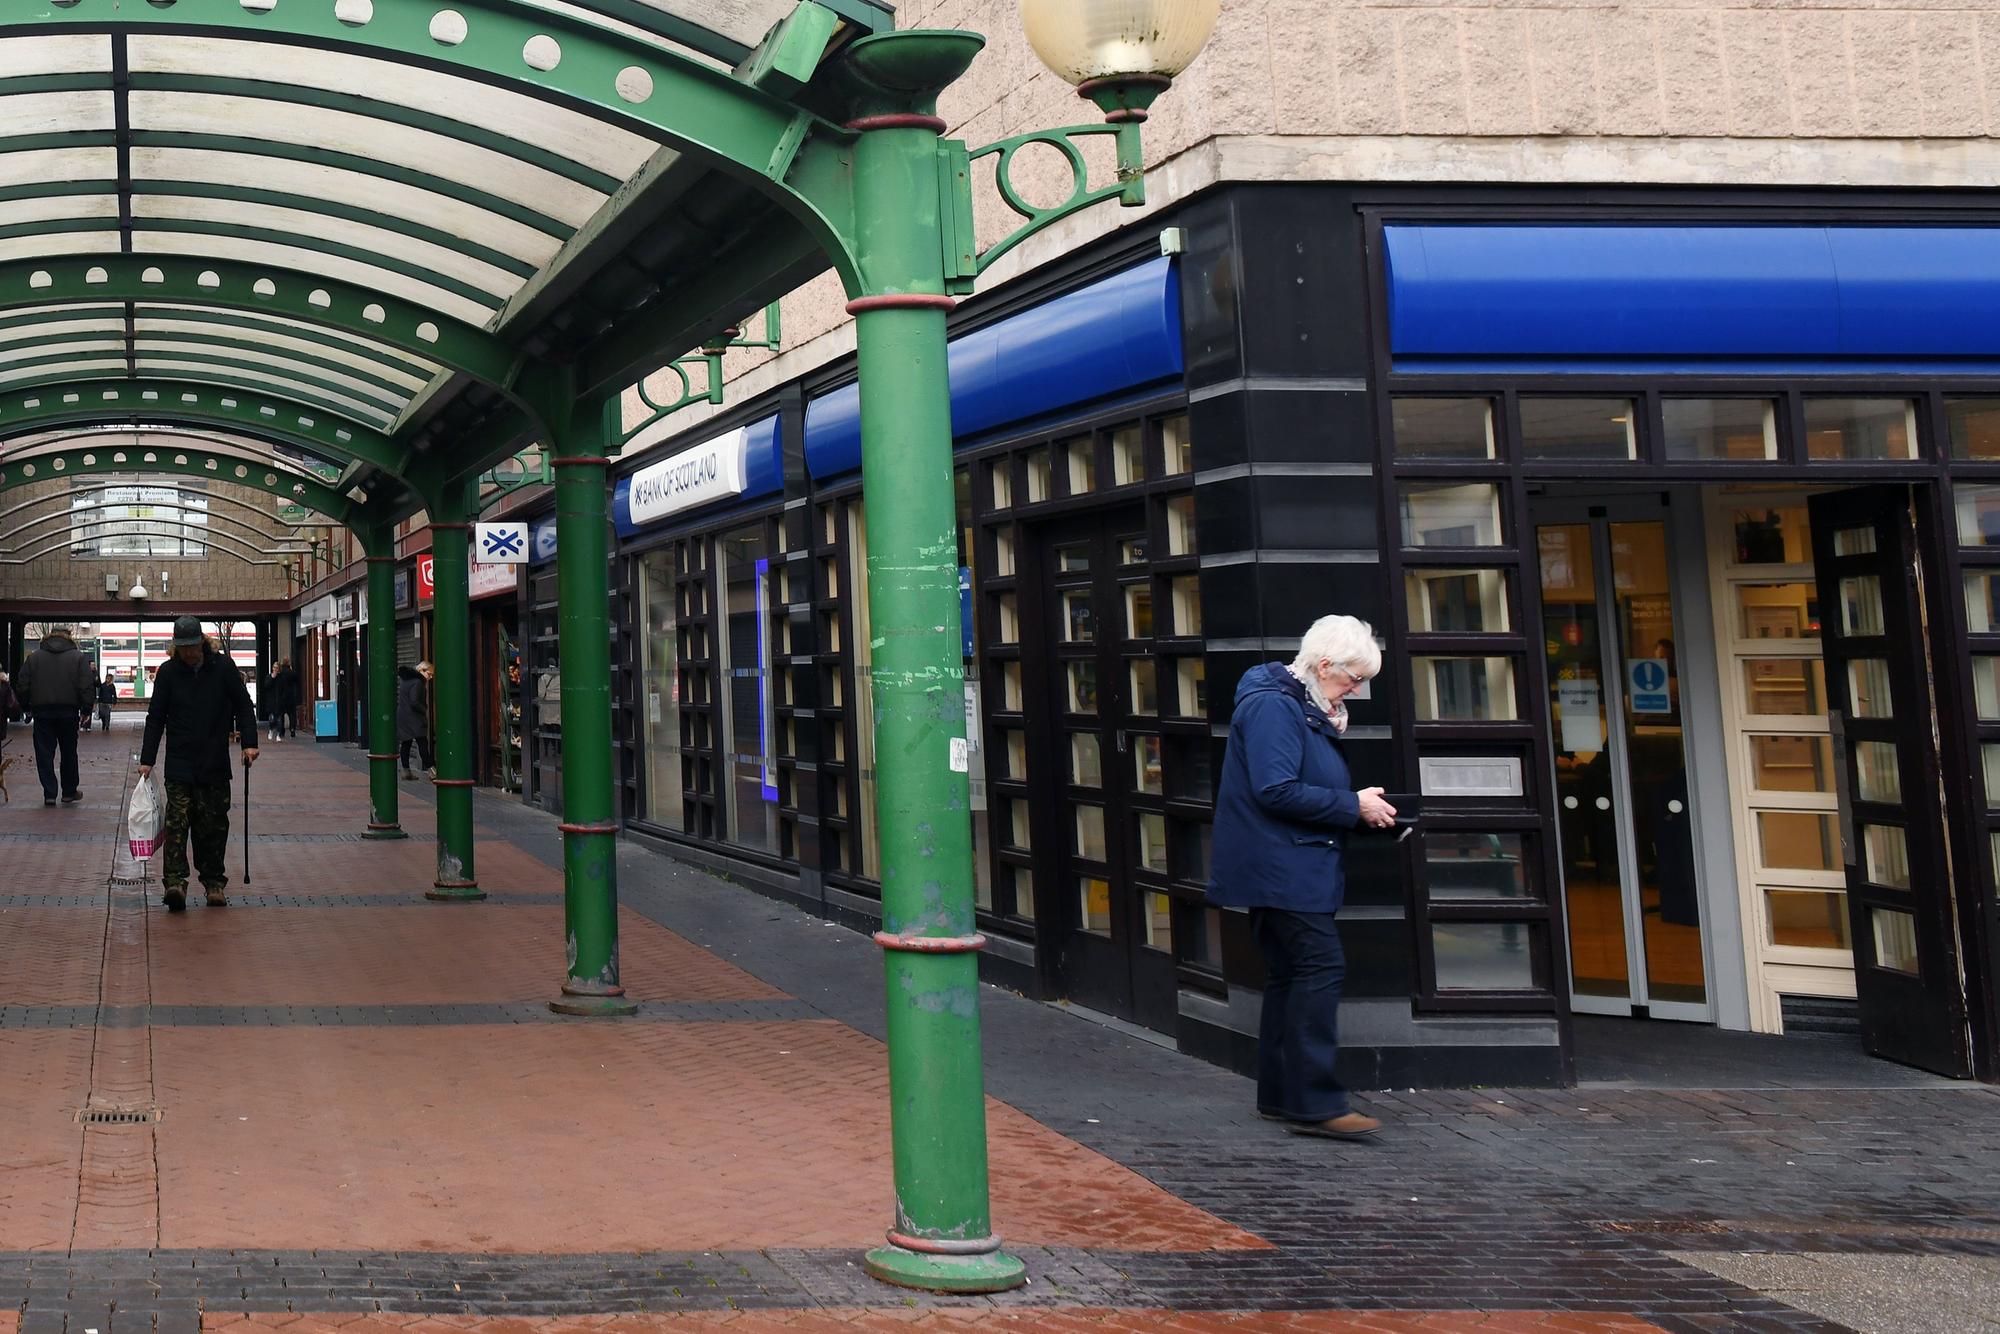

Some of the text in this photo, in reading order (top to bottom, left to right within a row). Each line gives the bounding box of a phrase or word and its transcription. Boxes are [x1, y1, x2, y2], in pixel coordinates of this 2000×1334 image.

[643, 452, 717, 505] BANK OF SCOTLAND
[1560, 688, 1597, 696] Automatic
